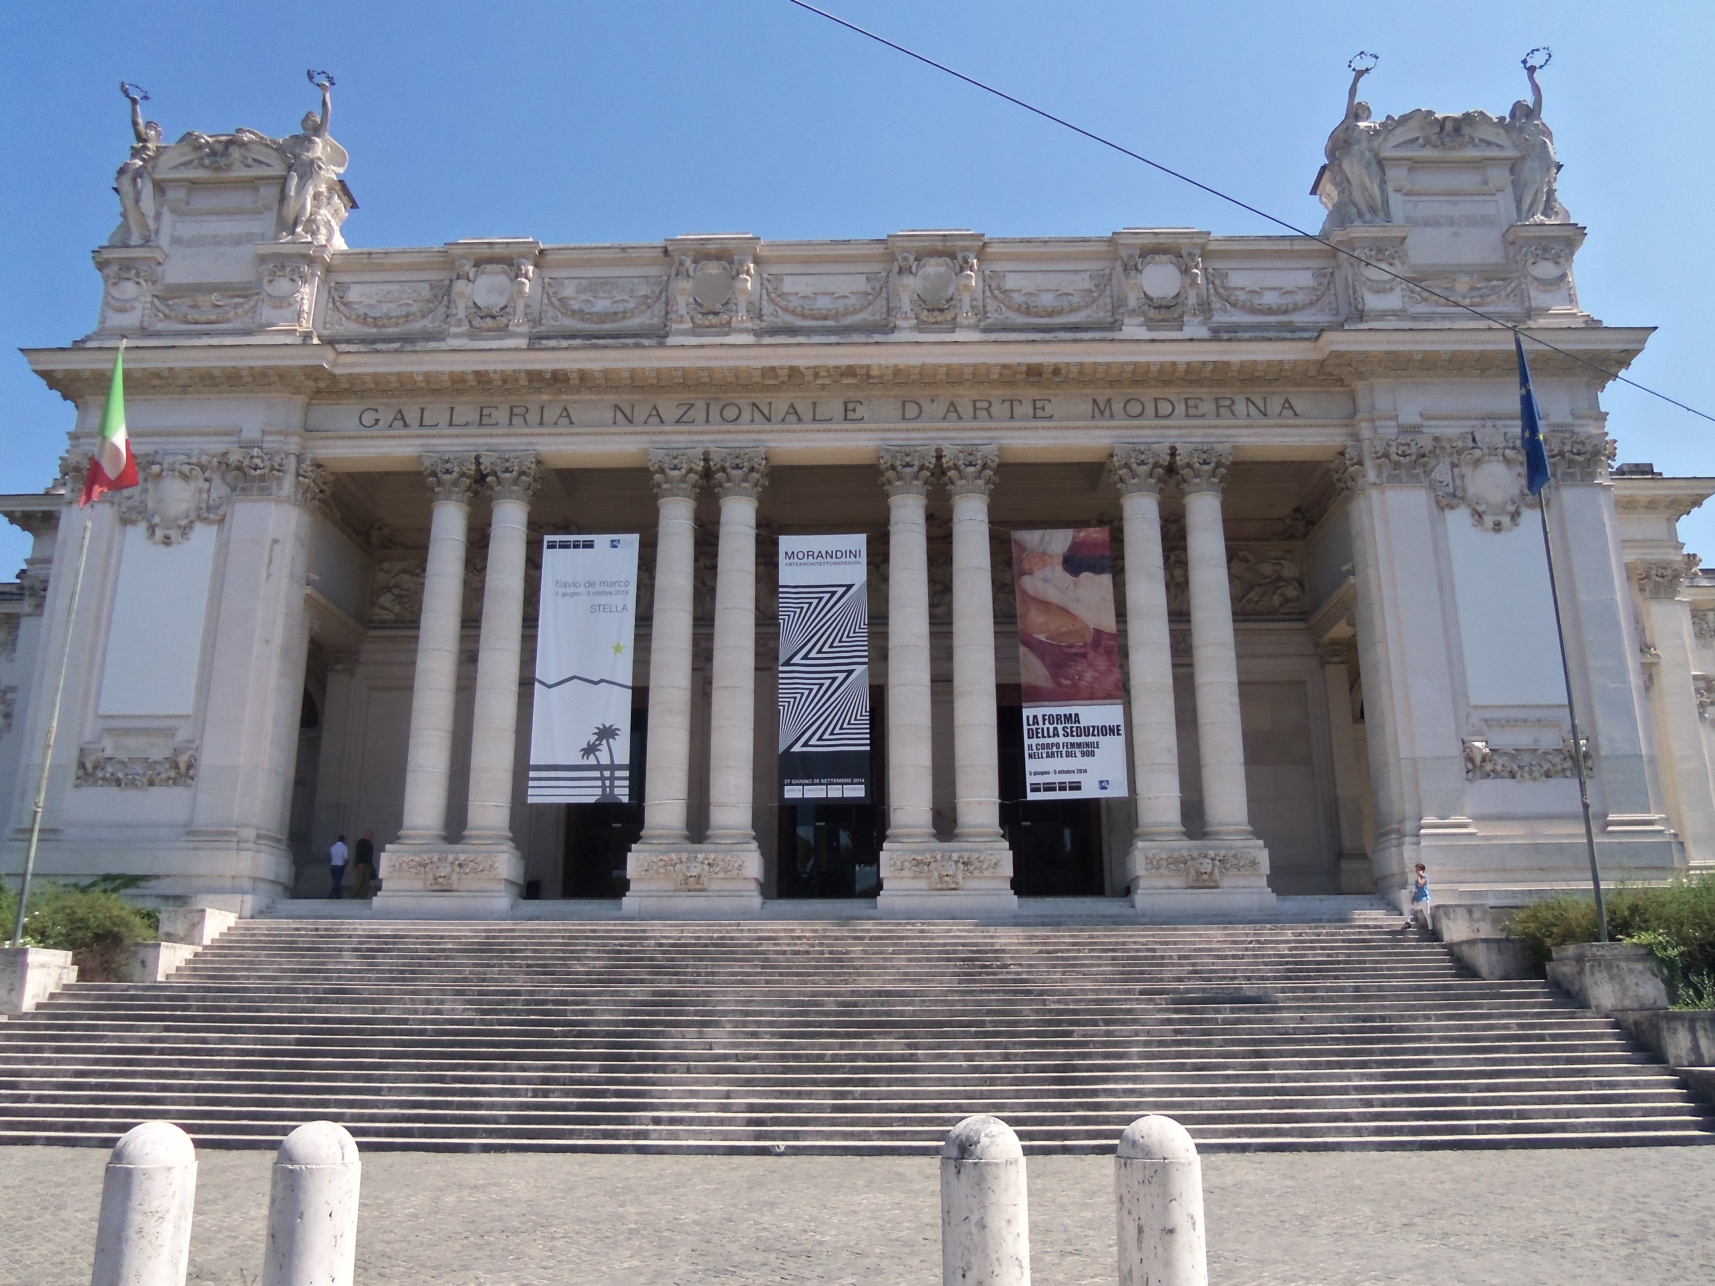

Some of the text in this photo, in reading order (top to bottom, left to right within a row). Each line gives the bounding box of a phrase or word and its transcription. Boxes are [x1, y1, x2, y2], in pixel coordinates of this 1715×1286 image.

[359, 396, 1301, 428] GALLERIA NAZIONALE D'ARTE MODERNA
[784, 549, 862, 560] MORANDINI
[555, 580, 581, 588] flavio
[584, 580, 596, 588] de
[590, 604, 628, 614] STELLA
[1026, 713, 1080, 726] LA FORMA
[1027, 724, 1122, 739] DELLA SEDUZIONE
[1036, 742, 1060, 751] CORPO
[1062, 741, 1100, 750] FEMMINILE
[1028, 751, 1064, 759] NELL'ARTE
